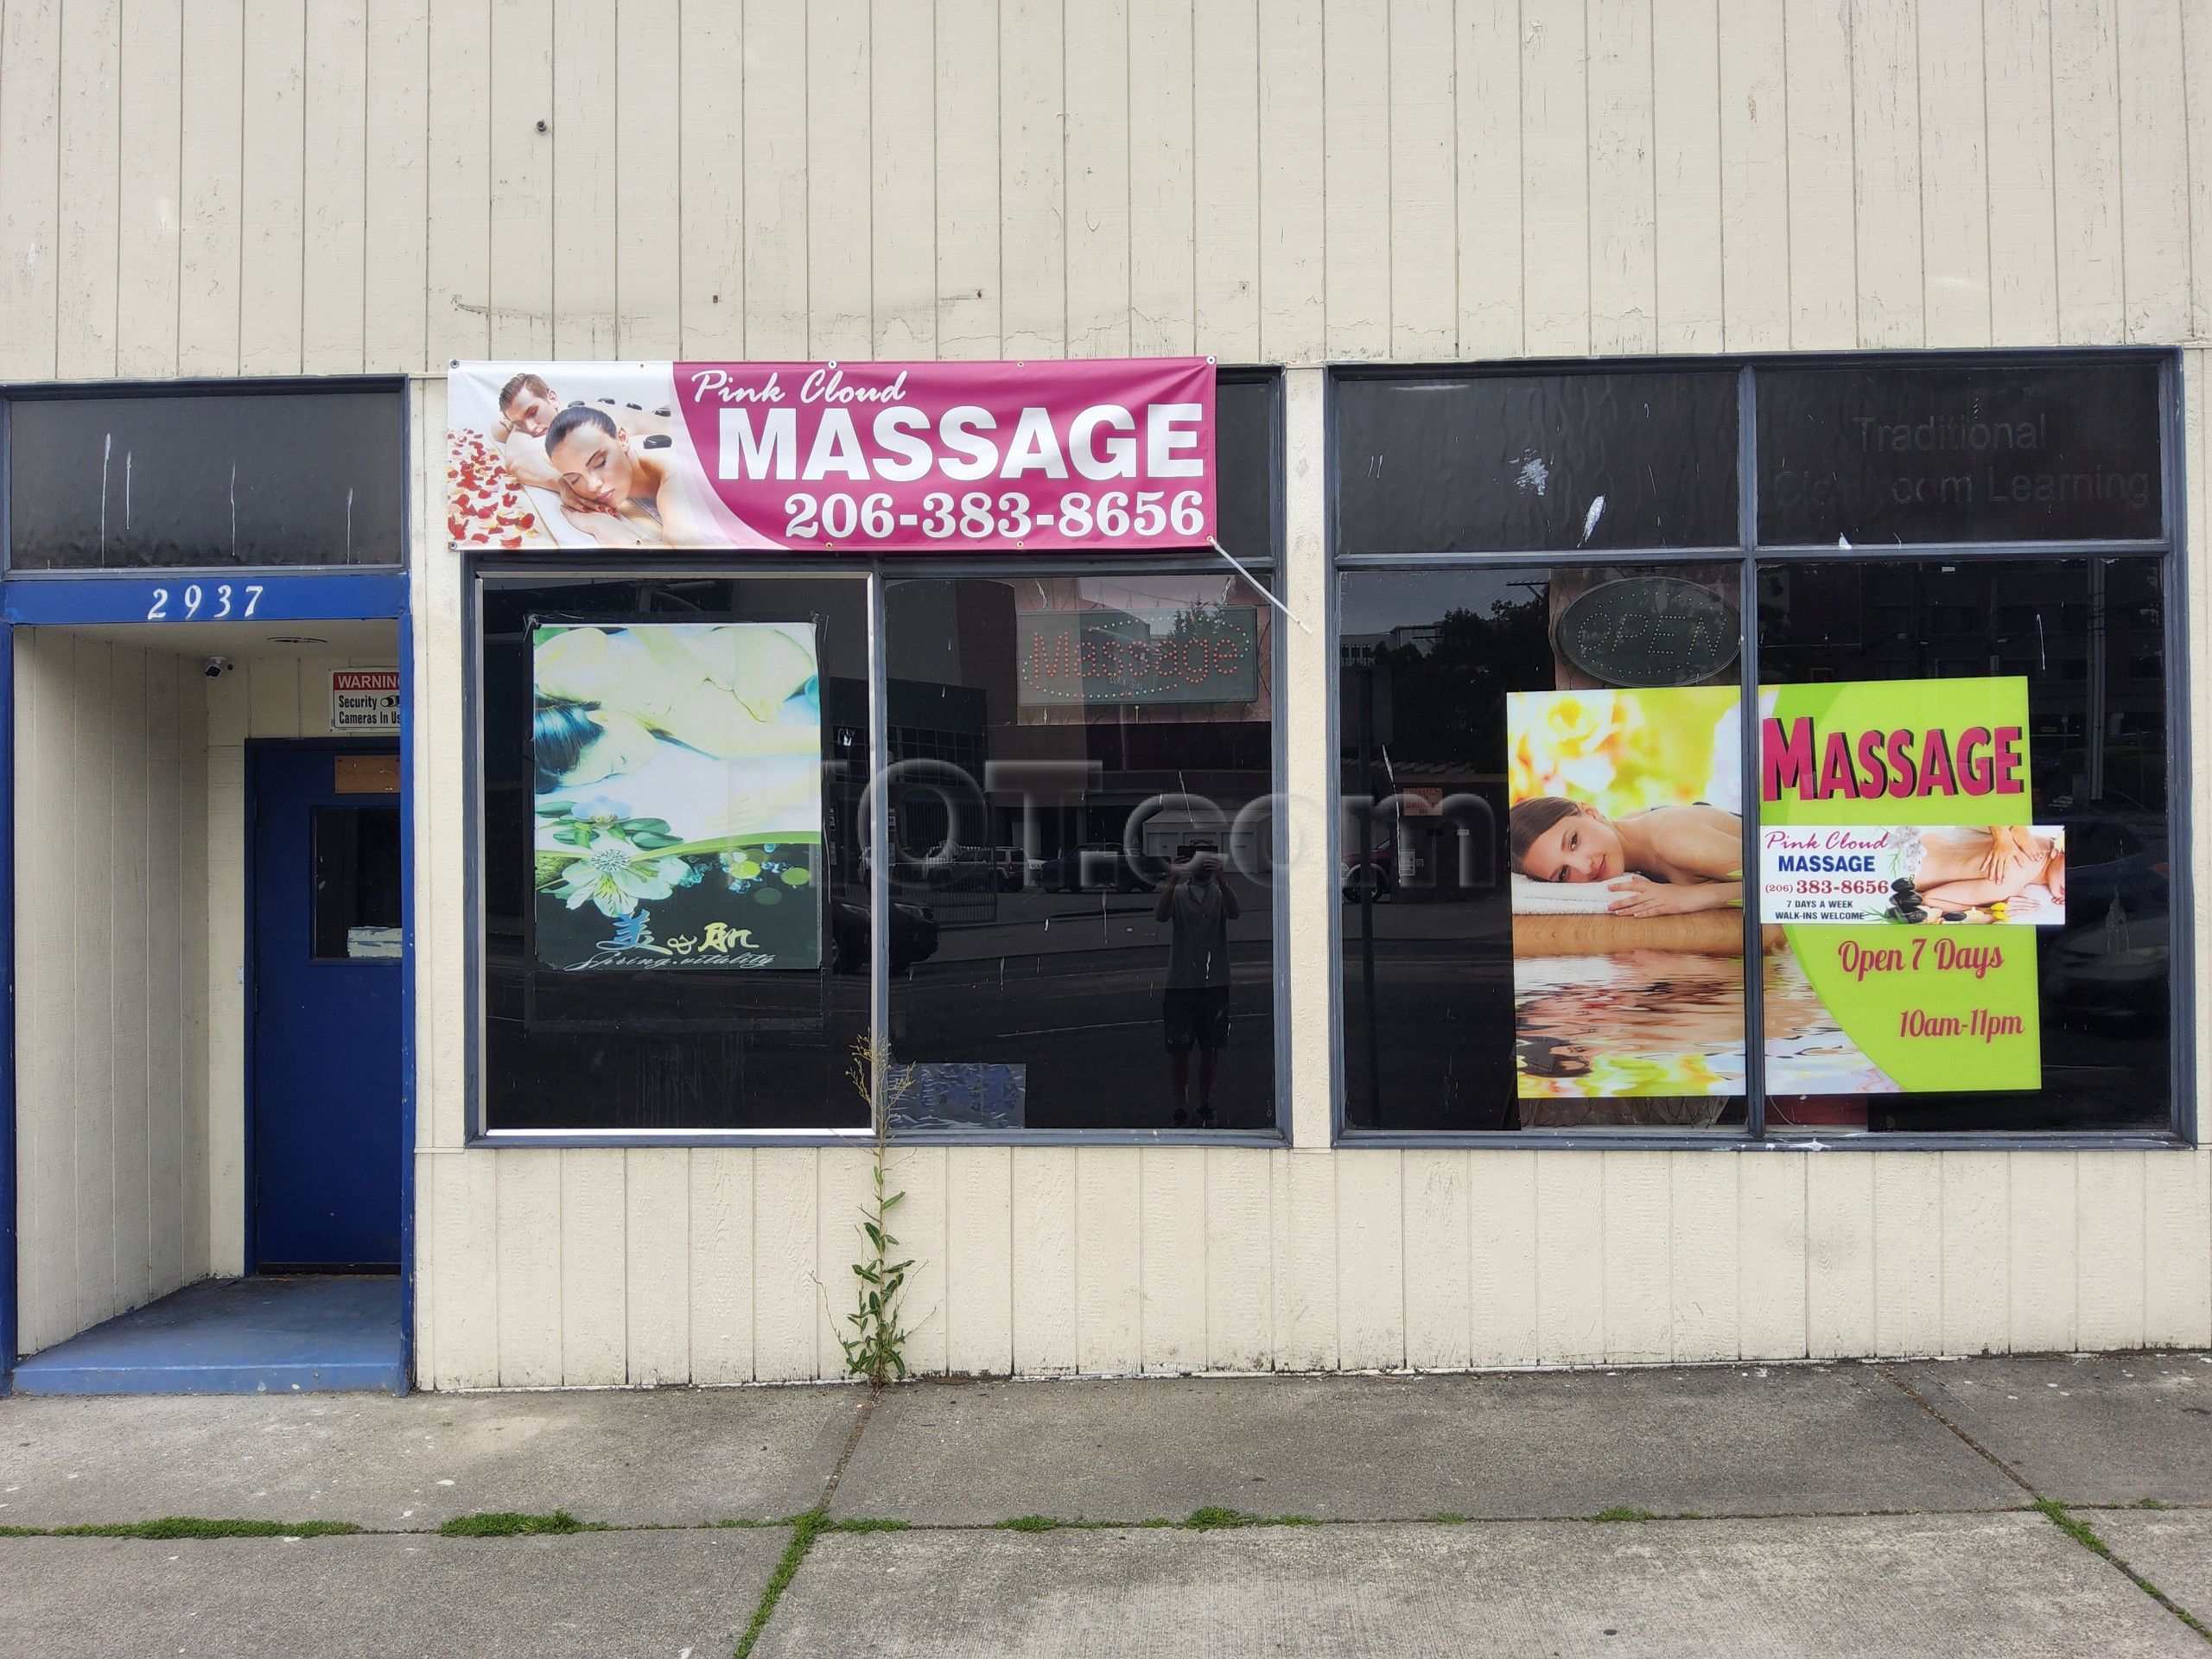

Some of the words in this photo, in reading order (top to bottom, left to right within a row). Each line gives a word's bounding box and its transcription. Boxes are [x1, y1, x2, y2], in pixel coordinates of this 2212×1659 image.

[690, 368, 785, 404] Pink
[800, 370, 906, 403] Cloud
[717, 404, 1204, 481] MASSAGE
[1853, 413, 2047, 451] Traditional
[1988, 465, 2150, 510] Learning
[785, 492, 1204, 538] 206-383-8656
[148, 585, 263, 620] 2937
[1579, 613, 1726, 657] OPEN
[1033, 631, 1238, 684] Massage
[338, 676, 400, 689] WARNIN
[339, 695, 378, 710] Security
[340, 711, 378, 724] Cameras
[380, 711, 388, 723] In
[1763, 716, 2024, 802] MASSAGE
[1765, 831, 1820, 850] Pink
[1825, 830, 1889, 850] Cloud
[1778, 855, 1875, 873] MASSAGE
[1764, 882, 1793, 895] (206)
[1796, 880, 1889, 896] 383-8656
[1775, 912, 1818, 921] WALK-INS
[1821, 912, 1866, 921] WELCOME
[1837, 940, 1904, 982] Open
[1912, 938, 1926, 971] 7
[1934, 939, 2004, 980] Days
[1899, 1008, 2024, 1044] 10am-11pm
